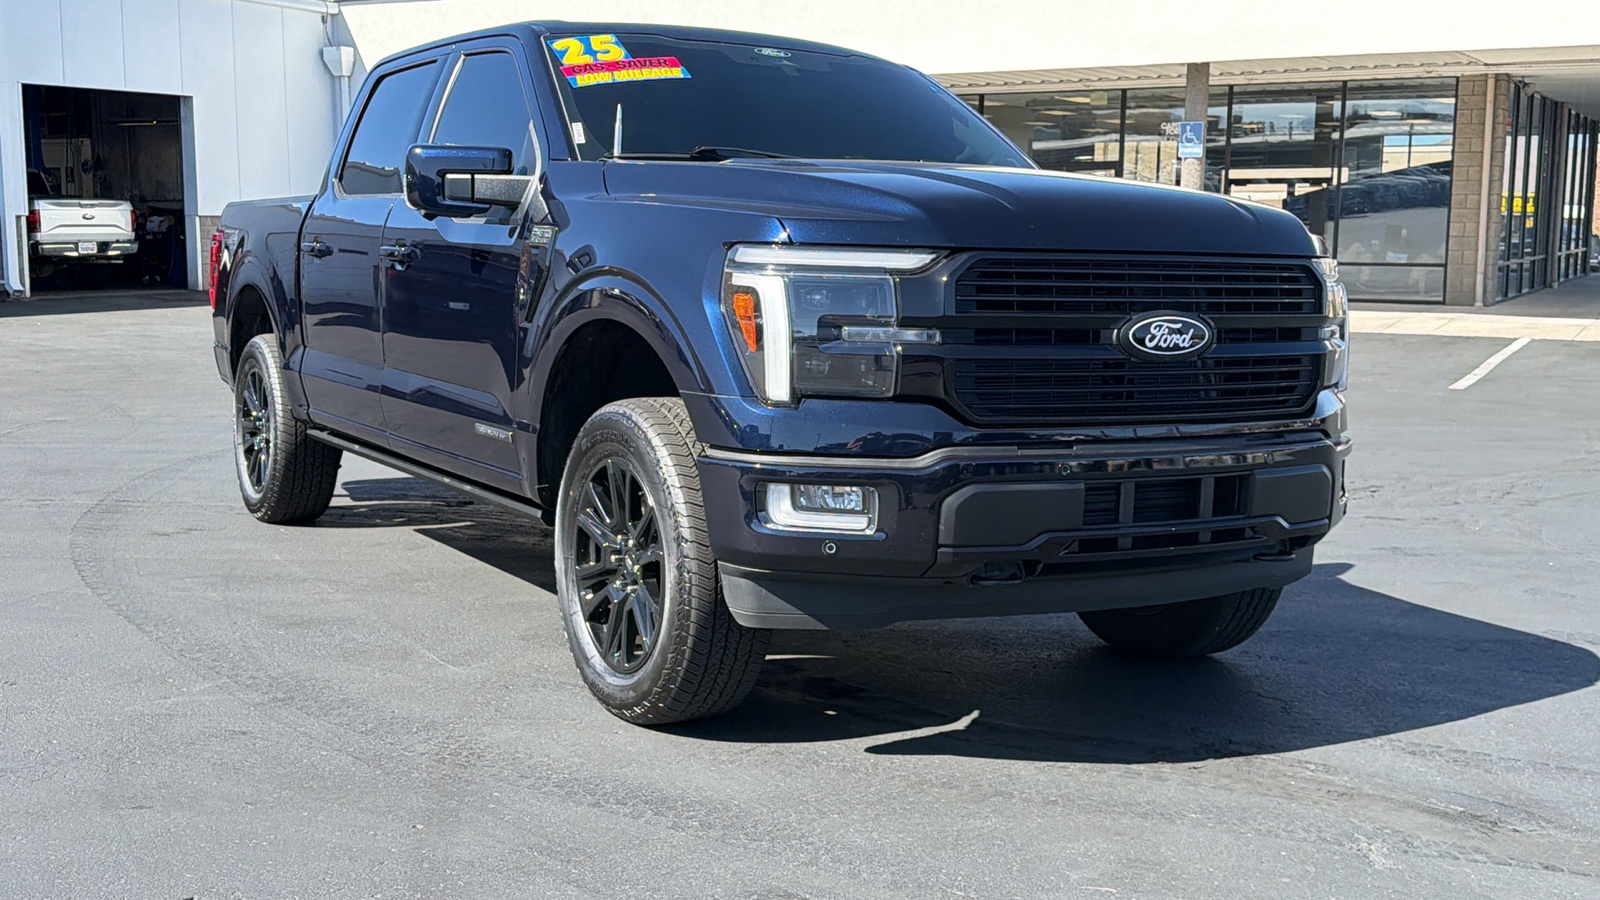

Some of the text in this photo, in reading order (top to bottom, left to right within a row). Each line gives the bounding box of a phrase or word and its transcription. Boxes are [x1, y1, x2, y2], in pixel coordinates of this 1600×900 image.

[553, 35, 625, 65] 25
[576, 67, 683, 86] LOW MILEAGE
[1145, 321, 1194, 348] Ford
